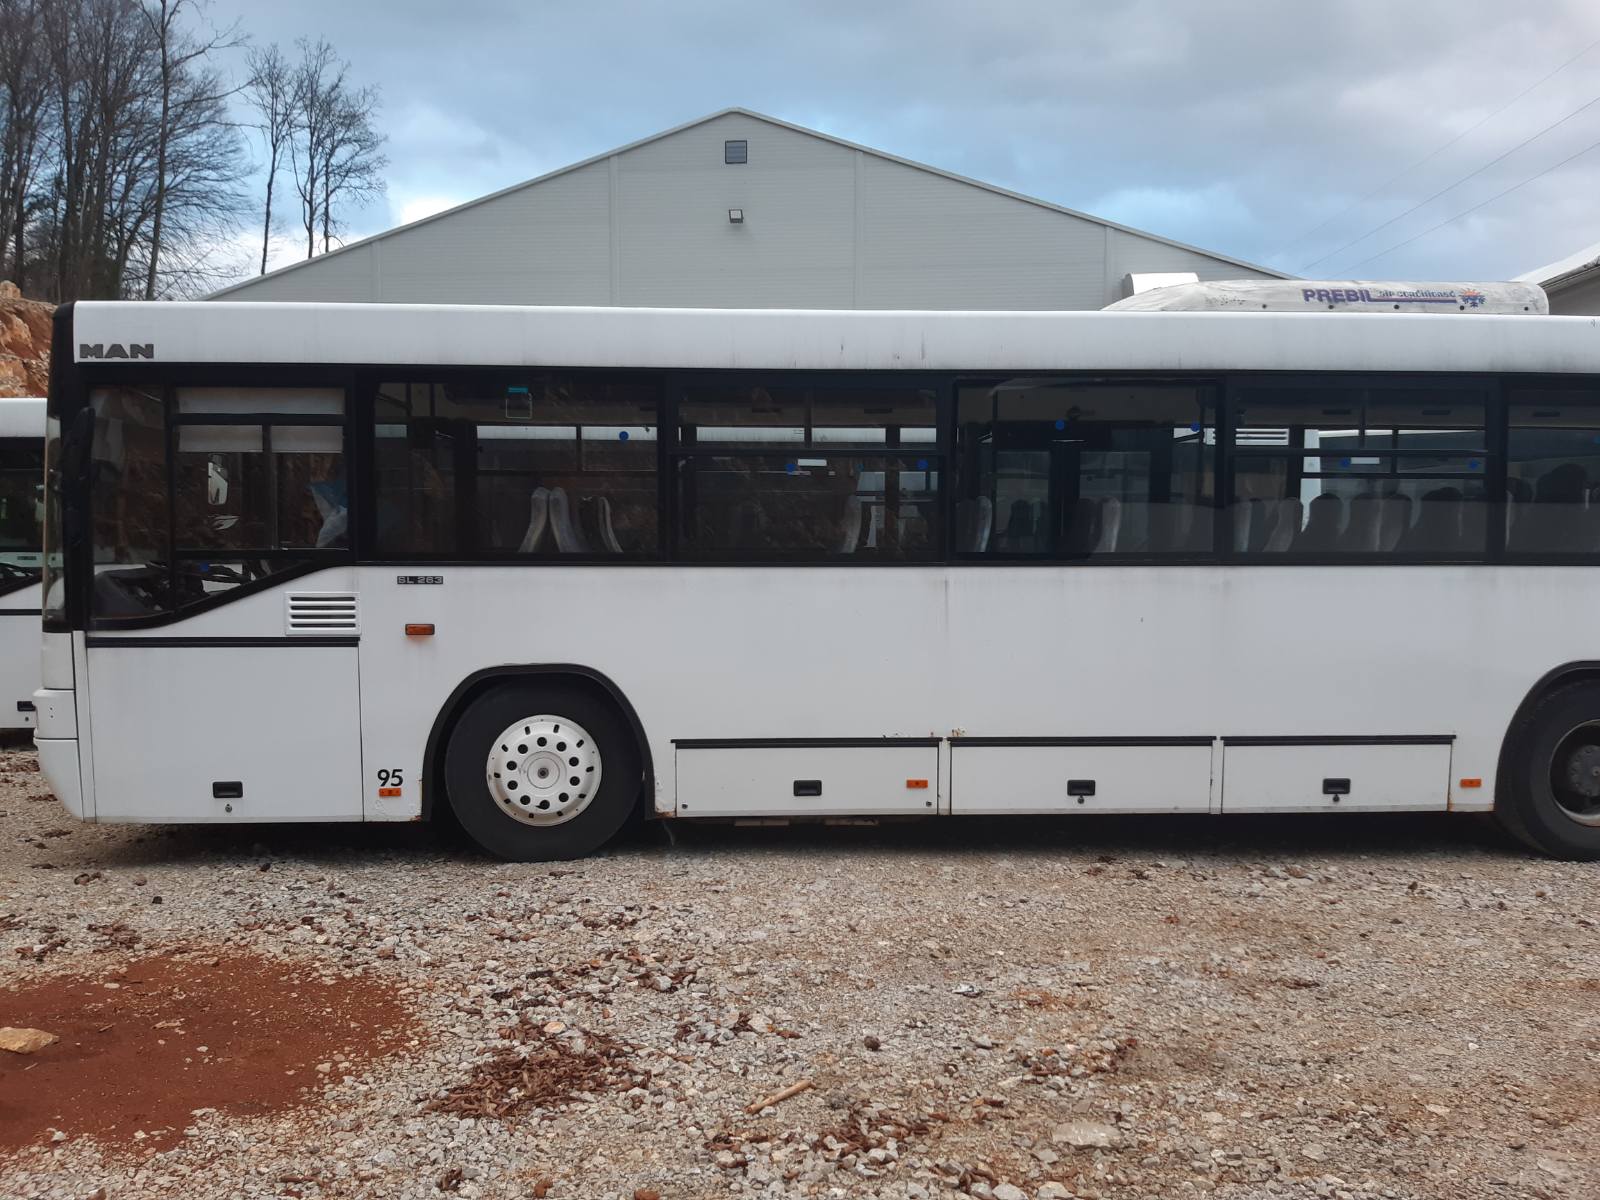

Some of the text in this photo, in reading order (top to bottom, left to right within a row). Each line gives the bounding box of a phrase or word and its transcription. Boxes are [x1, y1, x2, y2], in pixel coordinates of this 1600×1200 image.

[1302, 289, 1371, 302] PREBIL
[79, 344, 154, 359] MAN
[398, 576, 443, 584] SL 263
[377, 769, 404, 787] 95
